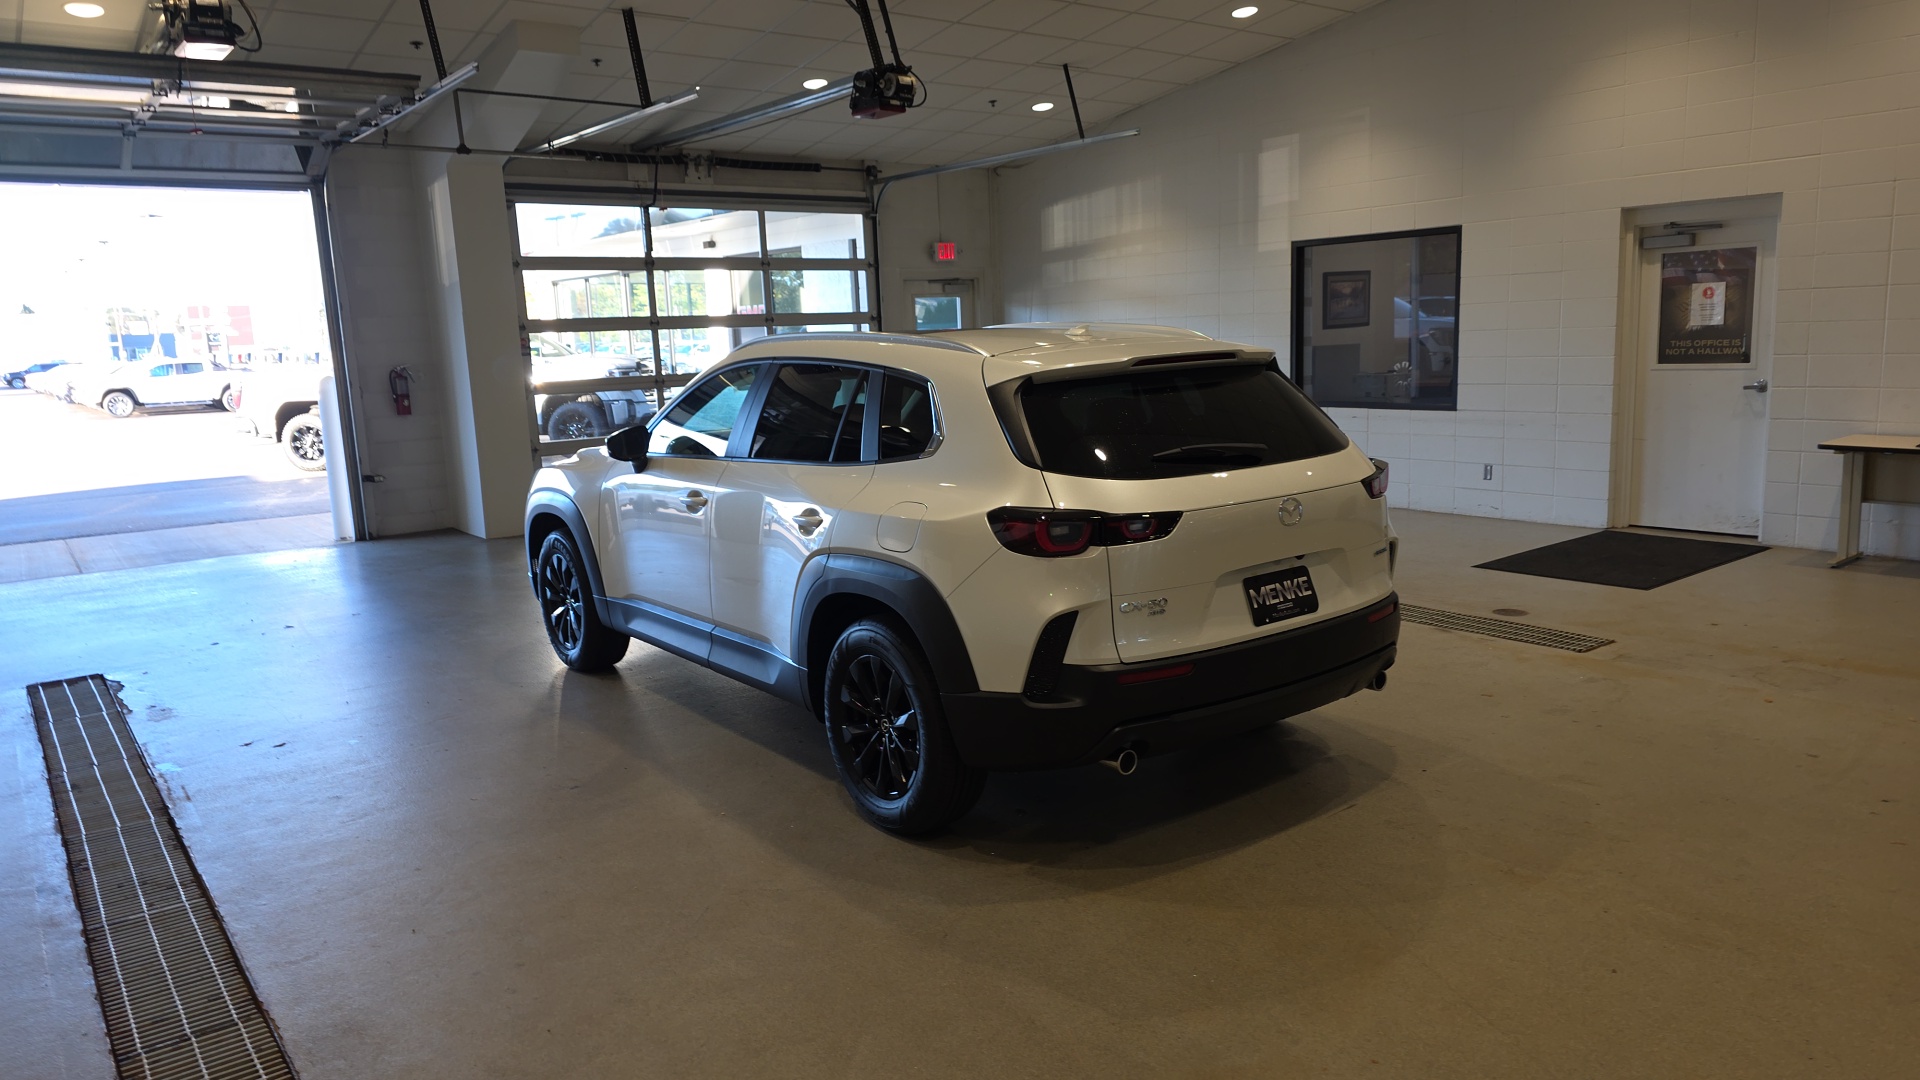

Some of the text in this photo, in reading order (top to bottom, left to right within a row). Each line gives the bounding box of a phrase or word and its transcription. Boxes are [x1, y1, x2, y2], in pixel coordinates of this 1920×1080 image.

[937, 242, 955, 260] EXIT
[1694, 339, 1730, 347] OFFICE
[1697, 347, 1745, 355] HALLWAY
[1249, 576, 1313, 609] MENKE
